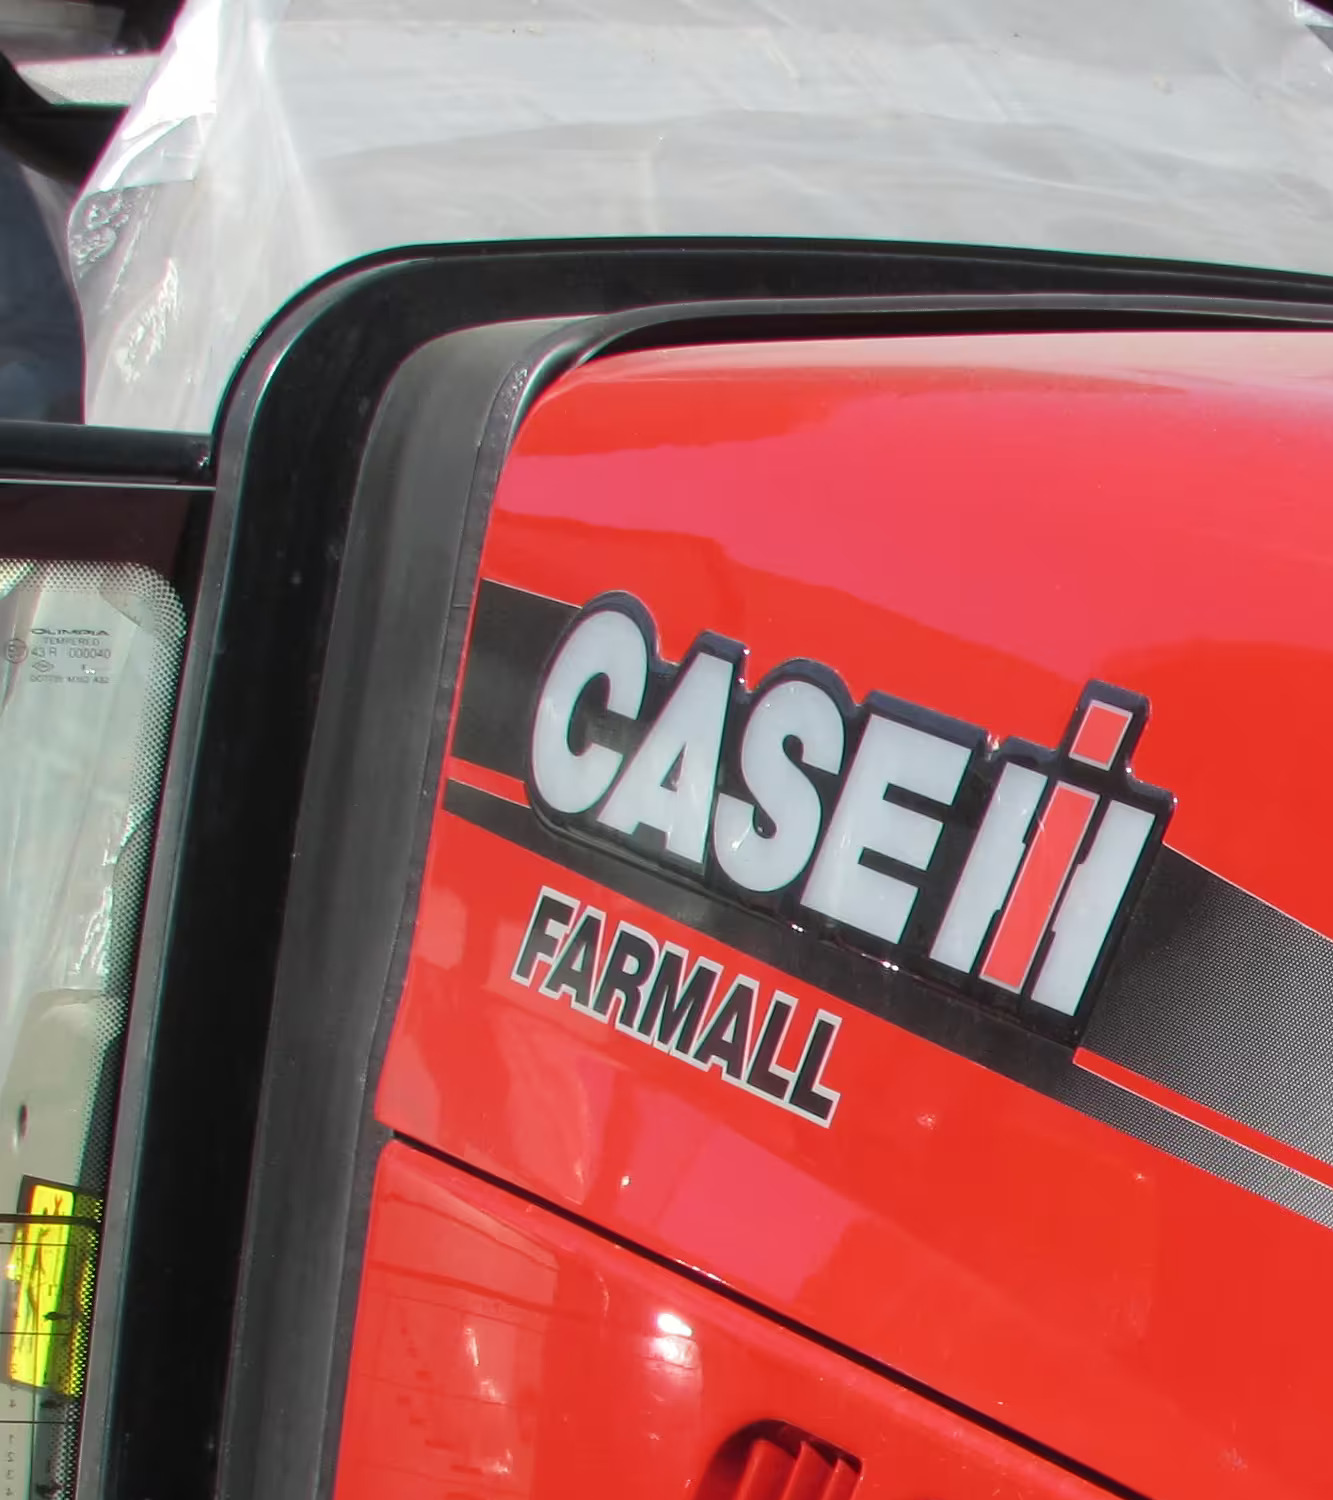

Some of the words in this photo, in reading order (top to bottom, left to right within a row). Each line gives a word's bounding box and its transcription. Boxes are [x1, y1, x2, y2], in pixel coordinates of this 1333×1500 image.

[31, 647, 45, 658] 43
[530, 607, 973, 945] CASE
[511, 885, 842, 1128] FARMALL
